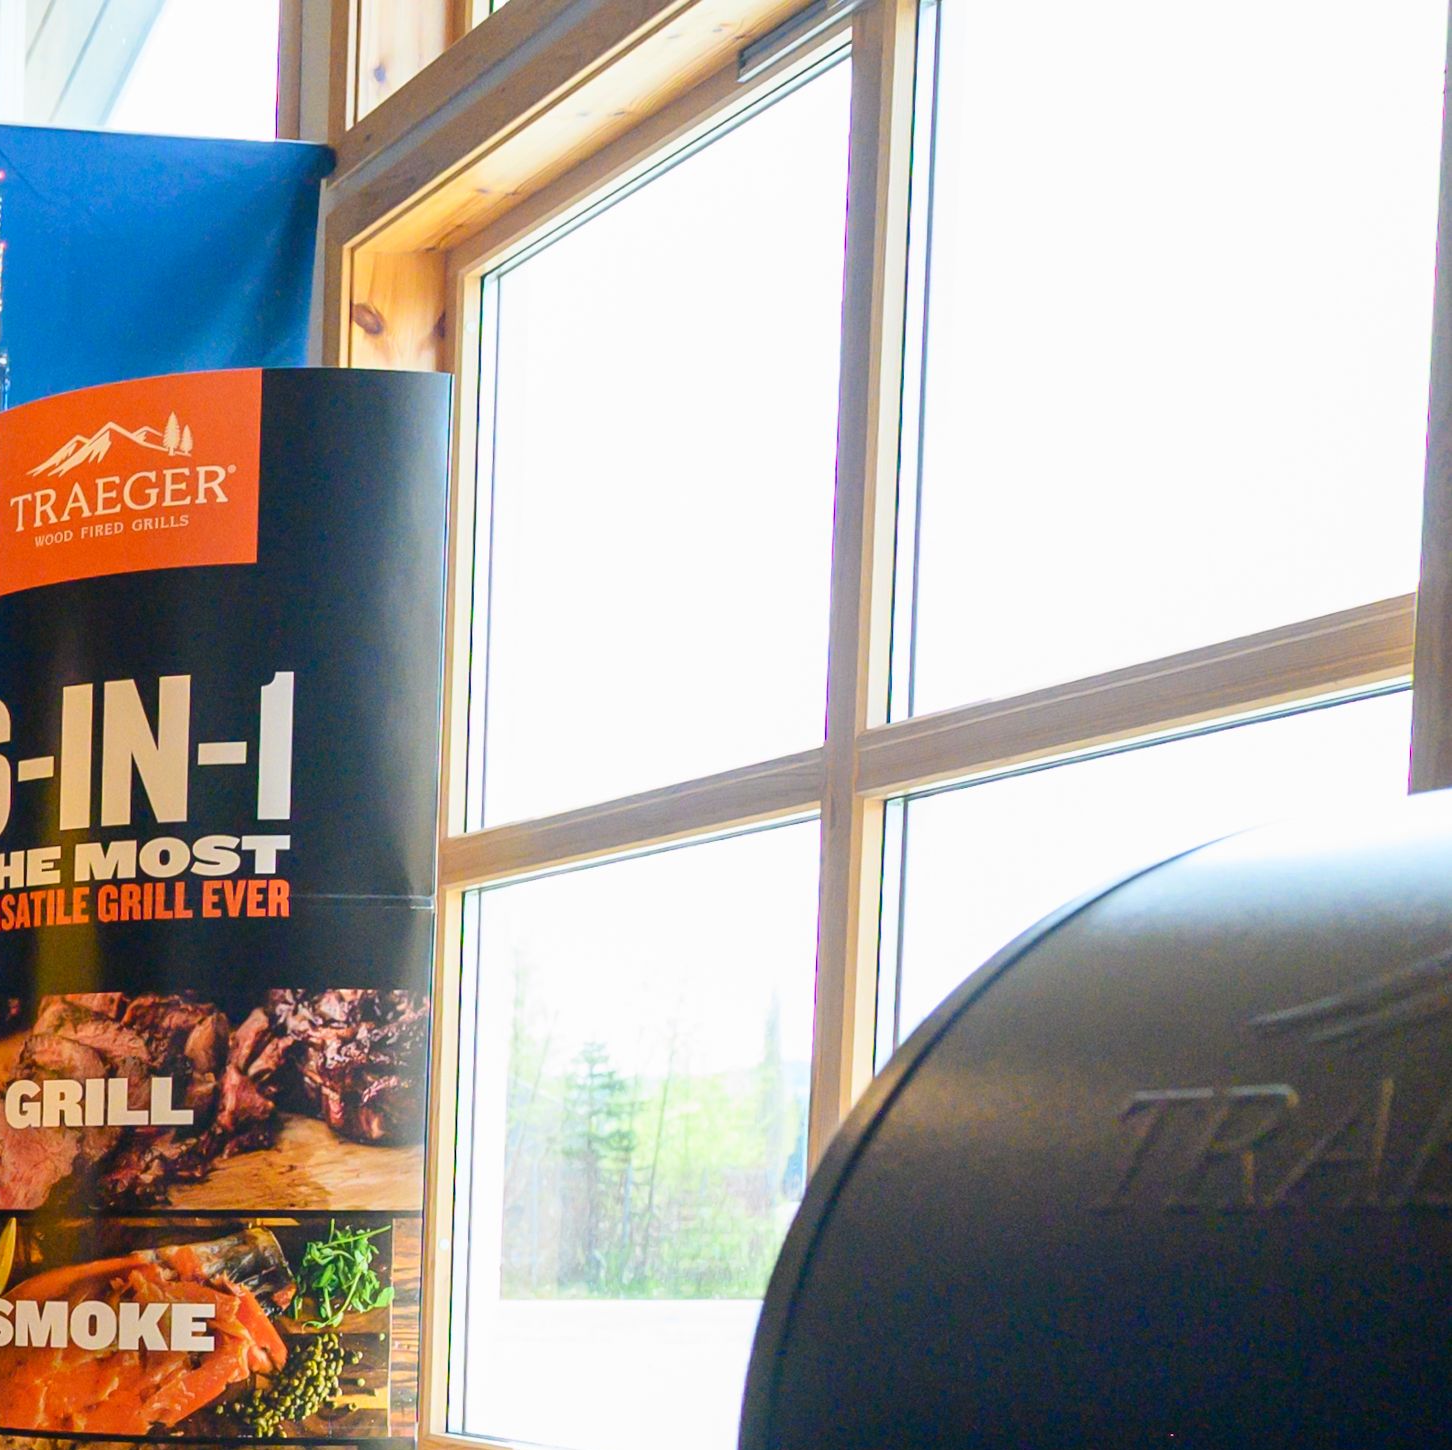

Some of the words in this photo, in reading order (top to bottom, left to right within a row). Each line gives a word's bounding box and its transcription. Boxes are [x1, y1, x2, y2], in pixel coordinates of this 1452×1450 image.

[10, 464, 229, 532] TRAEGER
[34, 530, 74, 548] WOOD
[80, 521, 124, 540] FIRED
[131, 514, 190, 533] GRILLS
[74, 834, 291, 883] MOST
[97, 881, 194, 923] GRILL
[202, 878, 291, 919] EVER
[4, 1076, 194, 1130] GRILL
[1096, 1074, 1452, 1216] TRA
